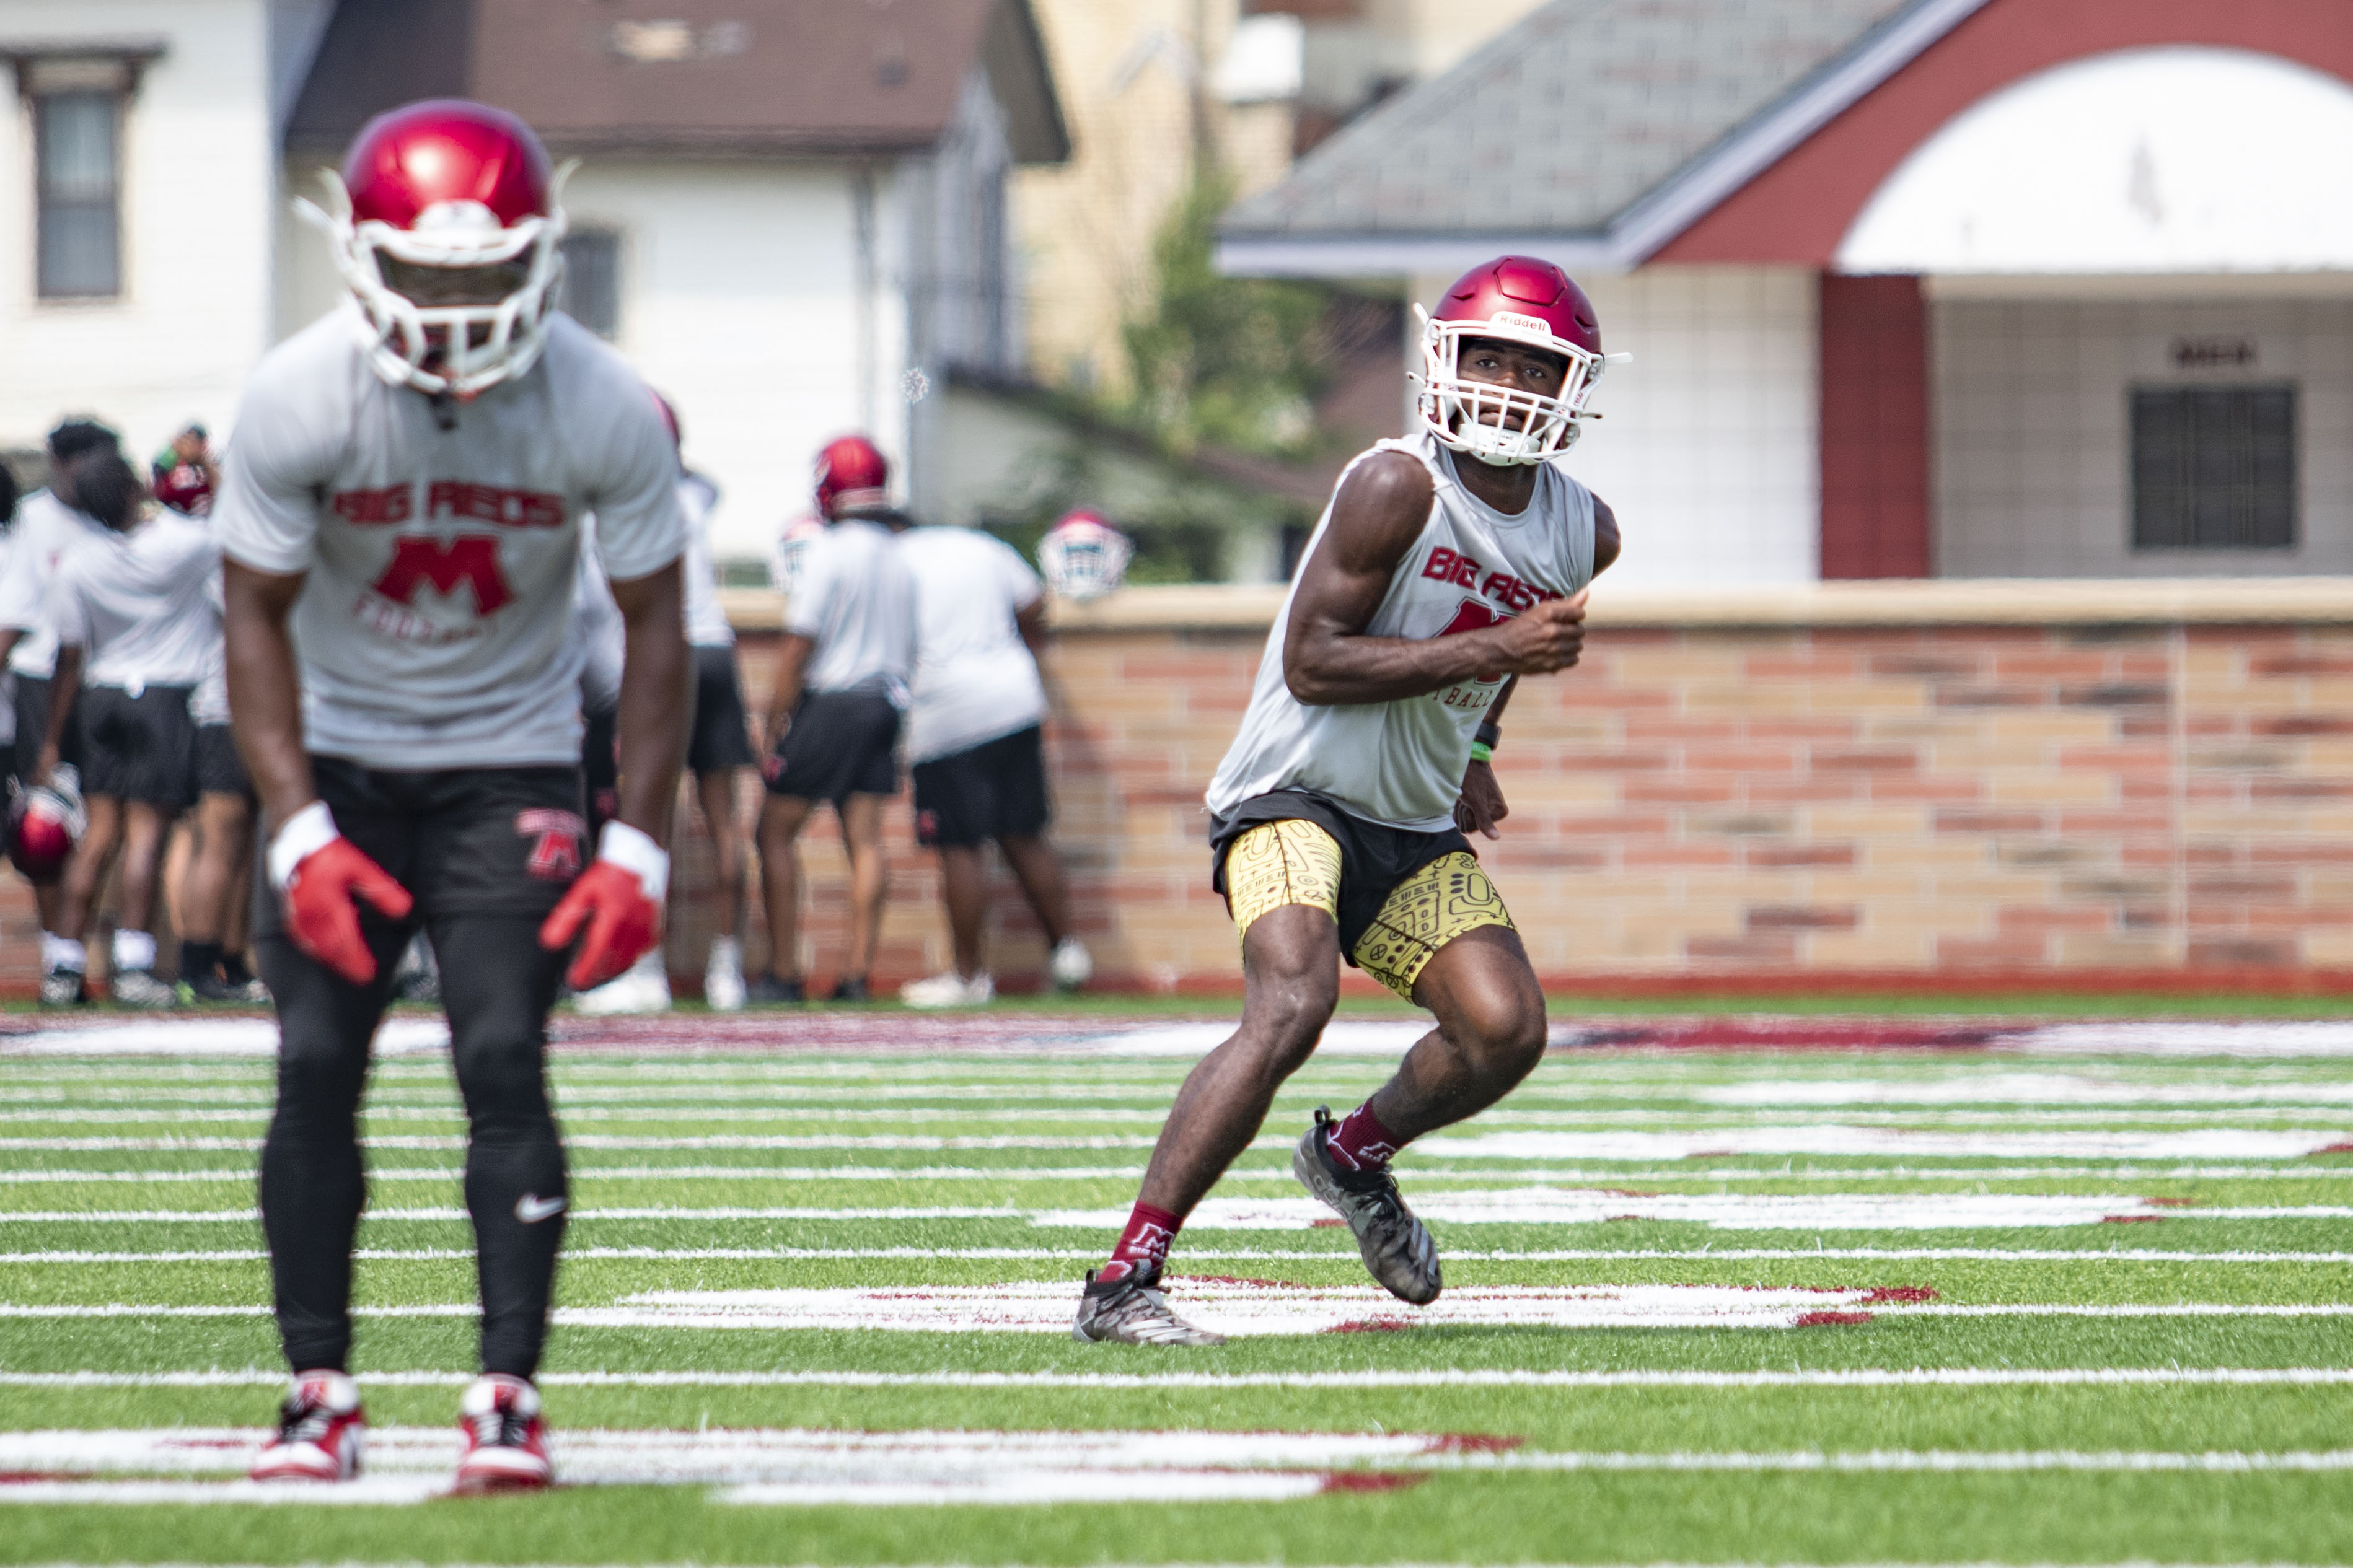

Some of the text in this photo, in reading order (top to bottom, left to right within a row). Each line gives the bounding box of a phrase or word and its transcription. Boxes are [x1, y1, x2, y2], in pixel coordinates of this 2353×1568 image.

[1500, 314, 1546, 331] Riddell
[333, 480, 565, 528] BIG REDS
[369, 533, 522, 616] M
[1421, 545, 1565, 611] BIG RED
